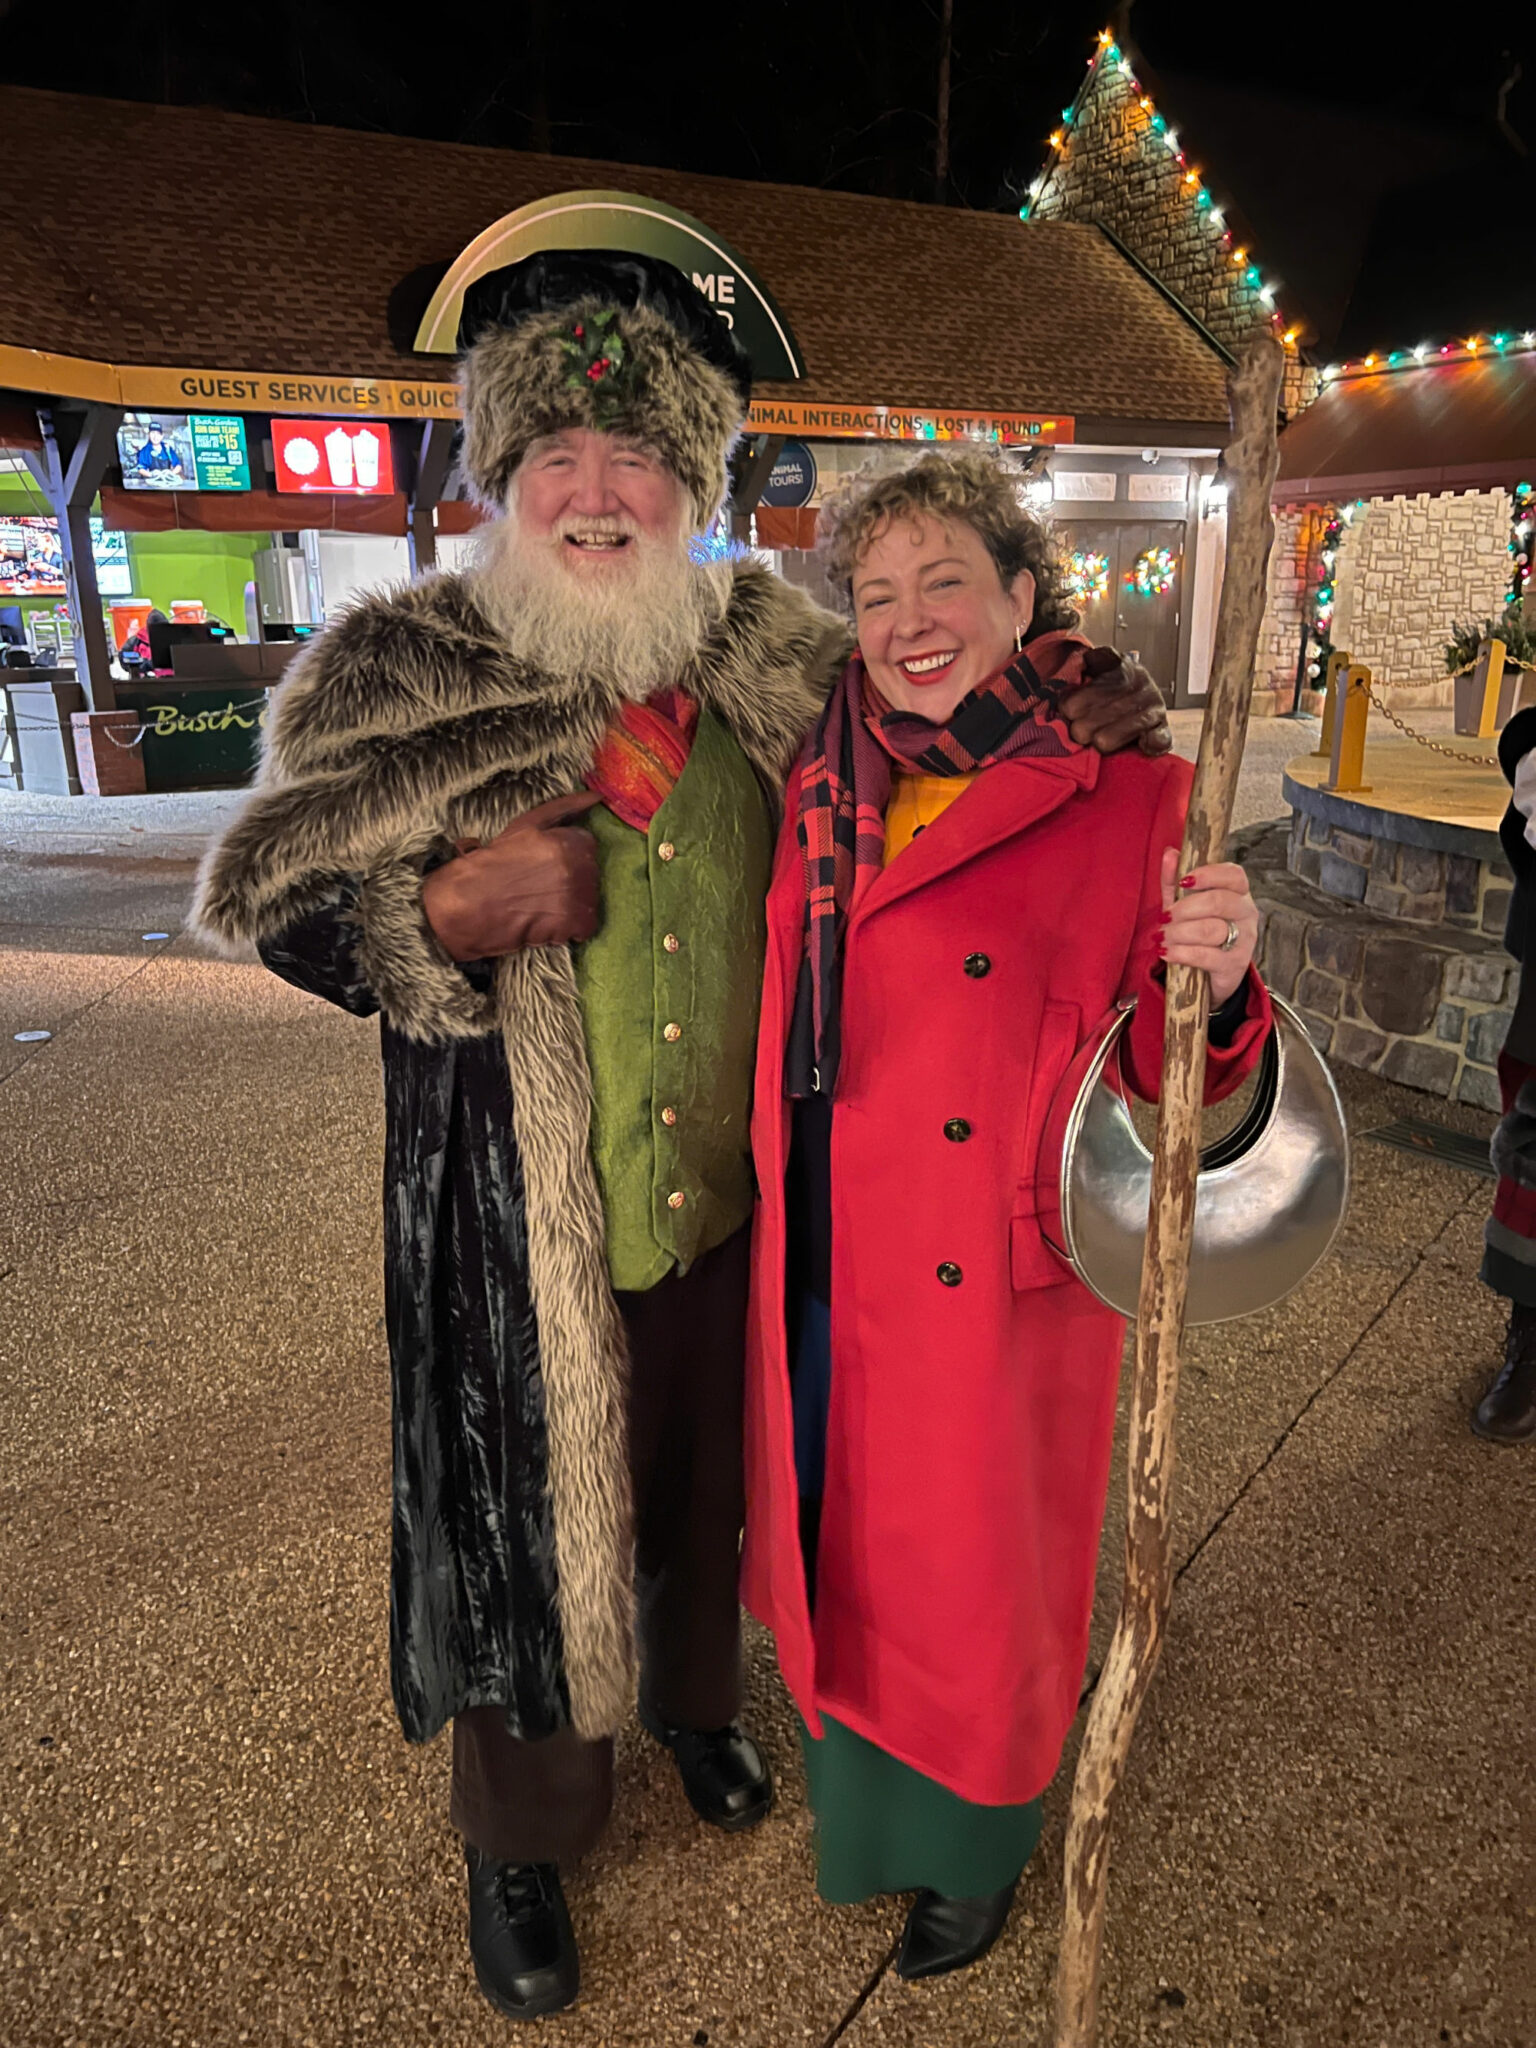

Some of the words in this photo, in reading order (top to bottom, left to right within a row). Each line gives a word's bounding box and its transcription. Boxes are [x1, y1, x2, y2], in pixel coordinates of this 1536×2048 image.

[682, 271, 736, 304] ME
[180, 377, 260, 399] GUEST
[268, 382, 380, 405] SERVICES
[400, 388, 460, 408] QUIC
[748, 407, 799, 425] NIMAL
[803, 410, 923, 430] INTERACTIONS
[935, 416, 974, 432] LOST
[976, 418, 988, 432] &
[991, 419, 1043, 436] FOUND
[218, 434, 239, 450] $15
[768, 474, 804, 487] TOURS!
[146, 701, 255, 736] Busch
